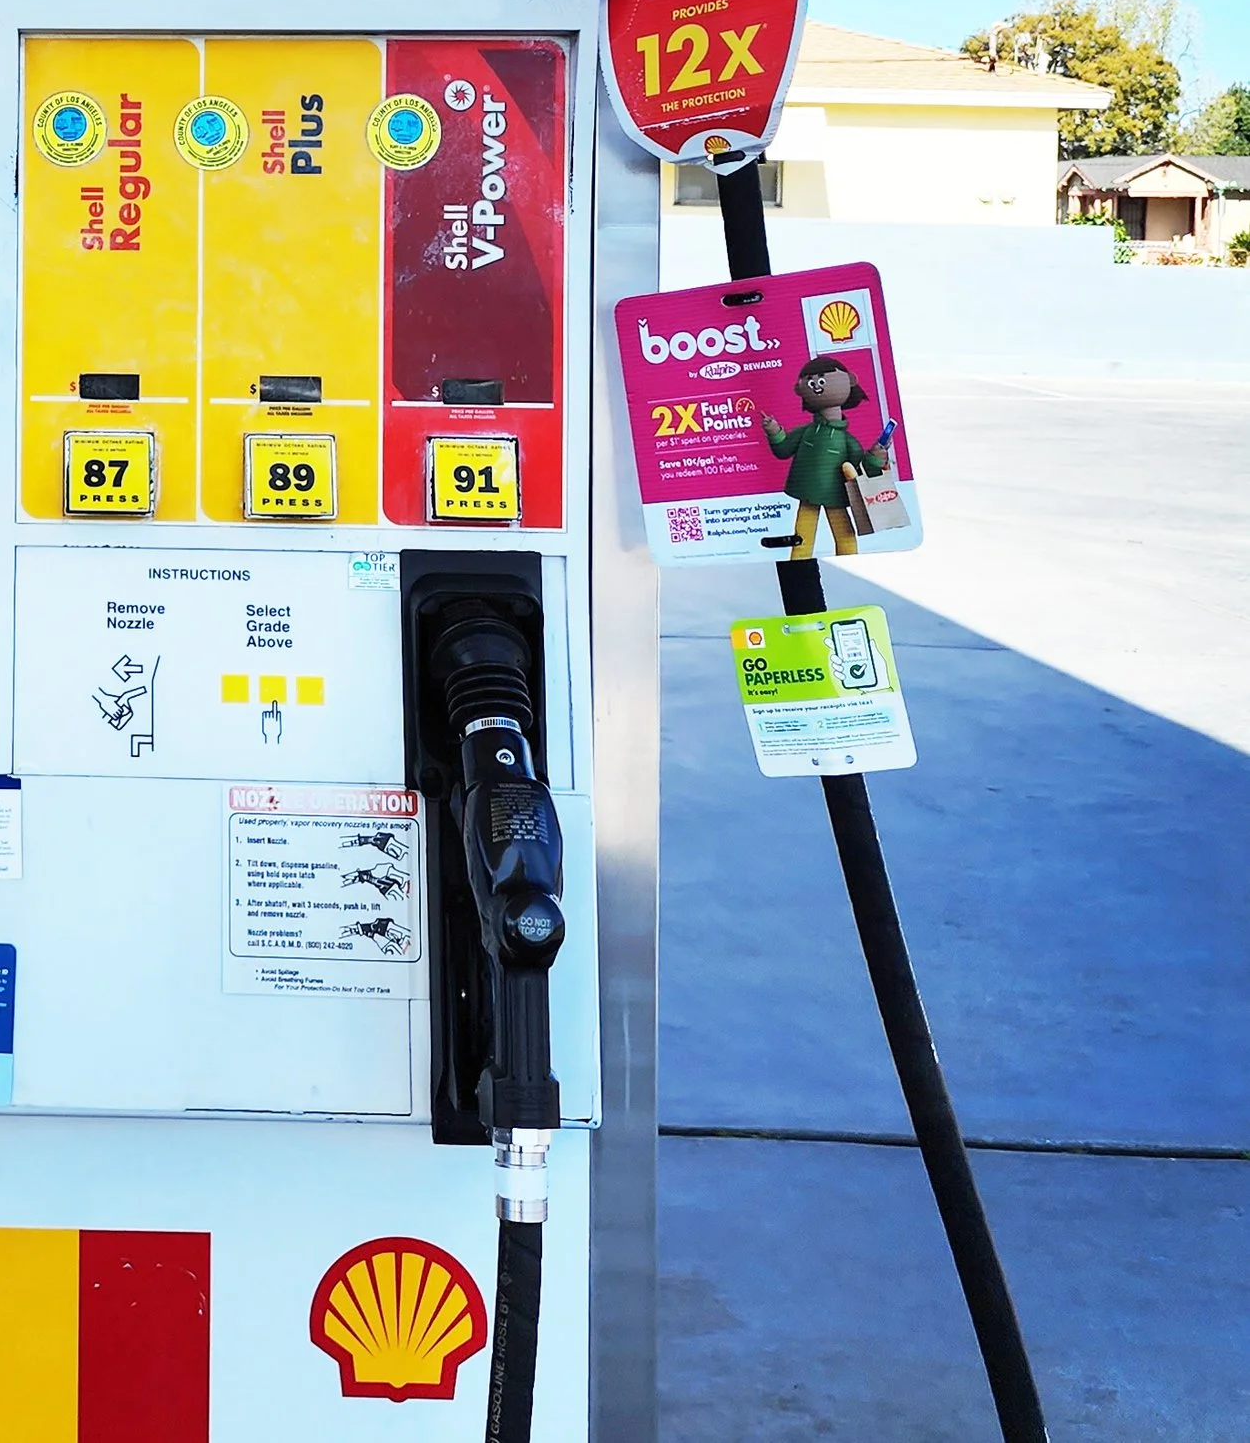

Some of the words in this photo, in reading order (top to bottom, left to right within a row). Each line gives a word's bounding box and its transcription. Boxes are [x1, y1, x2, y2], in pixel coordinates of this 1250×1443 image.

[661, 100, 679, 113] THE
[682, 87, 746, 109] PROTECTION
[290, 92, 324, 175] Plus
[261, 109, 285, 174] Shell
[108, 93, 150, 251] Regular
[80, 186, 105, 251] Shell
[443, 204, 468, 271] Shell
[637, 315, 767, 364] boost
[688, 371, 698, 379] by
[704, 363, 737, 378] Ralphs
[743, 359, 783, 372] REWARDS
[651, 403, 703, 437] 2X
[700, 397, 733, 417] Fuel
[702, 414, 752, 432] Points
[83, 460, 130, 488] 87
[268, 463, 316, 492] 89
[453, 465, 499, 494] 91
[80, 493, 140, 503] PRESS
[261, 497, 324, 506] PRESS
[445, 499, 507, 509] PRESS
[703, 508, 721, 516] Turn
[722, 506, 752, 516] grocery
[754, 502, 791, 512] shopping
[722, 514, 751, 523] savings
[762, 511, 781, 519] Shell
[364, 553, 385, 562] TOP
[372, 563, 395, 572] TIER
[148, 568, 251, 582] INSTRUCTIONS
[107, 601, 165, 615] Remove
[246, 604, 291, 617] Select
[107, 617, 155, 630] Nozzle
[246, 620, 291, 633] Grade
[246, 635, 293, 648] Above
[742, 657, 768, 672] GO
[744, 667, 825, 686] PAPERLESS
[760, 688, 778, 697] easy!
[520, 916, 534, 926] DO
[534, 917, 552, 927] NOT
[519, 926, 536, 935] TOP
[536, 927, 552, 937] OFF
